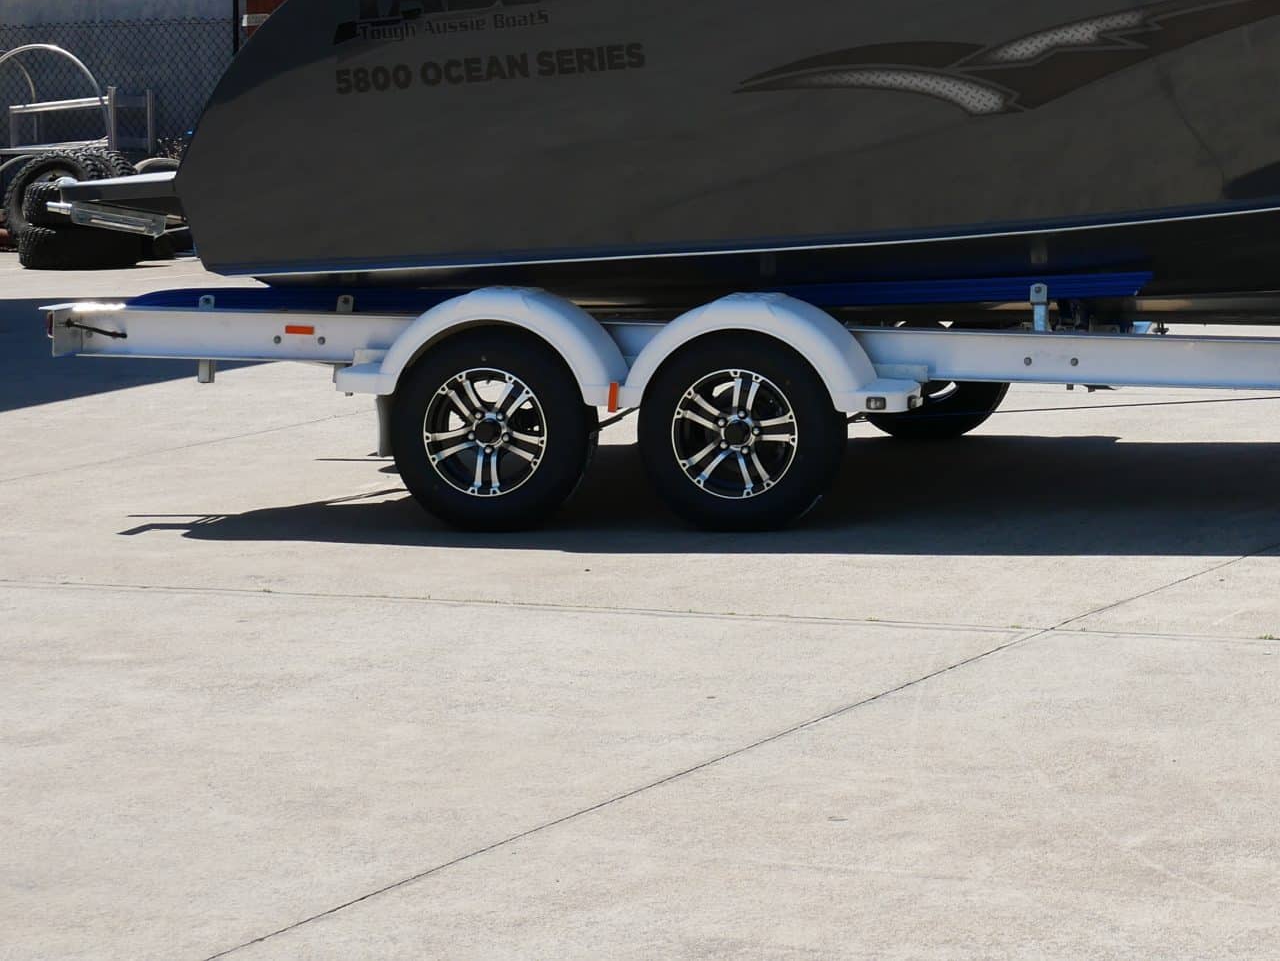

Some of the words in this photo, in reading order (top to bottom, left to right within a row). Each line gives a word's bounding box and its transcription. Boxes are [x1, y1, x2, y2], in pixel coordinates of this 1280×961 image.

[360, 22, 416, 40] Tough
[424, 17, 486, 34] Aussie
[494, 10, 549, 29] Boats
[335, 64, 412, 95] 5800
[420, 52, 529, 86] OCEAN
[537, 42, 646, 77] SERIES
